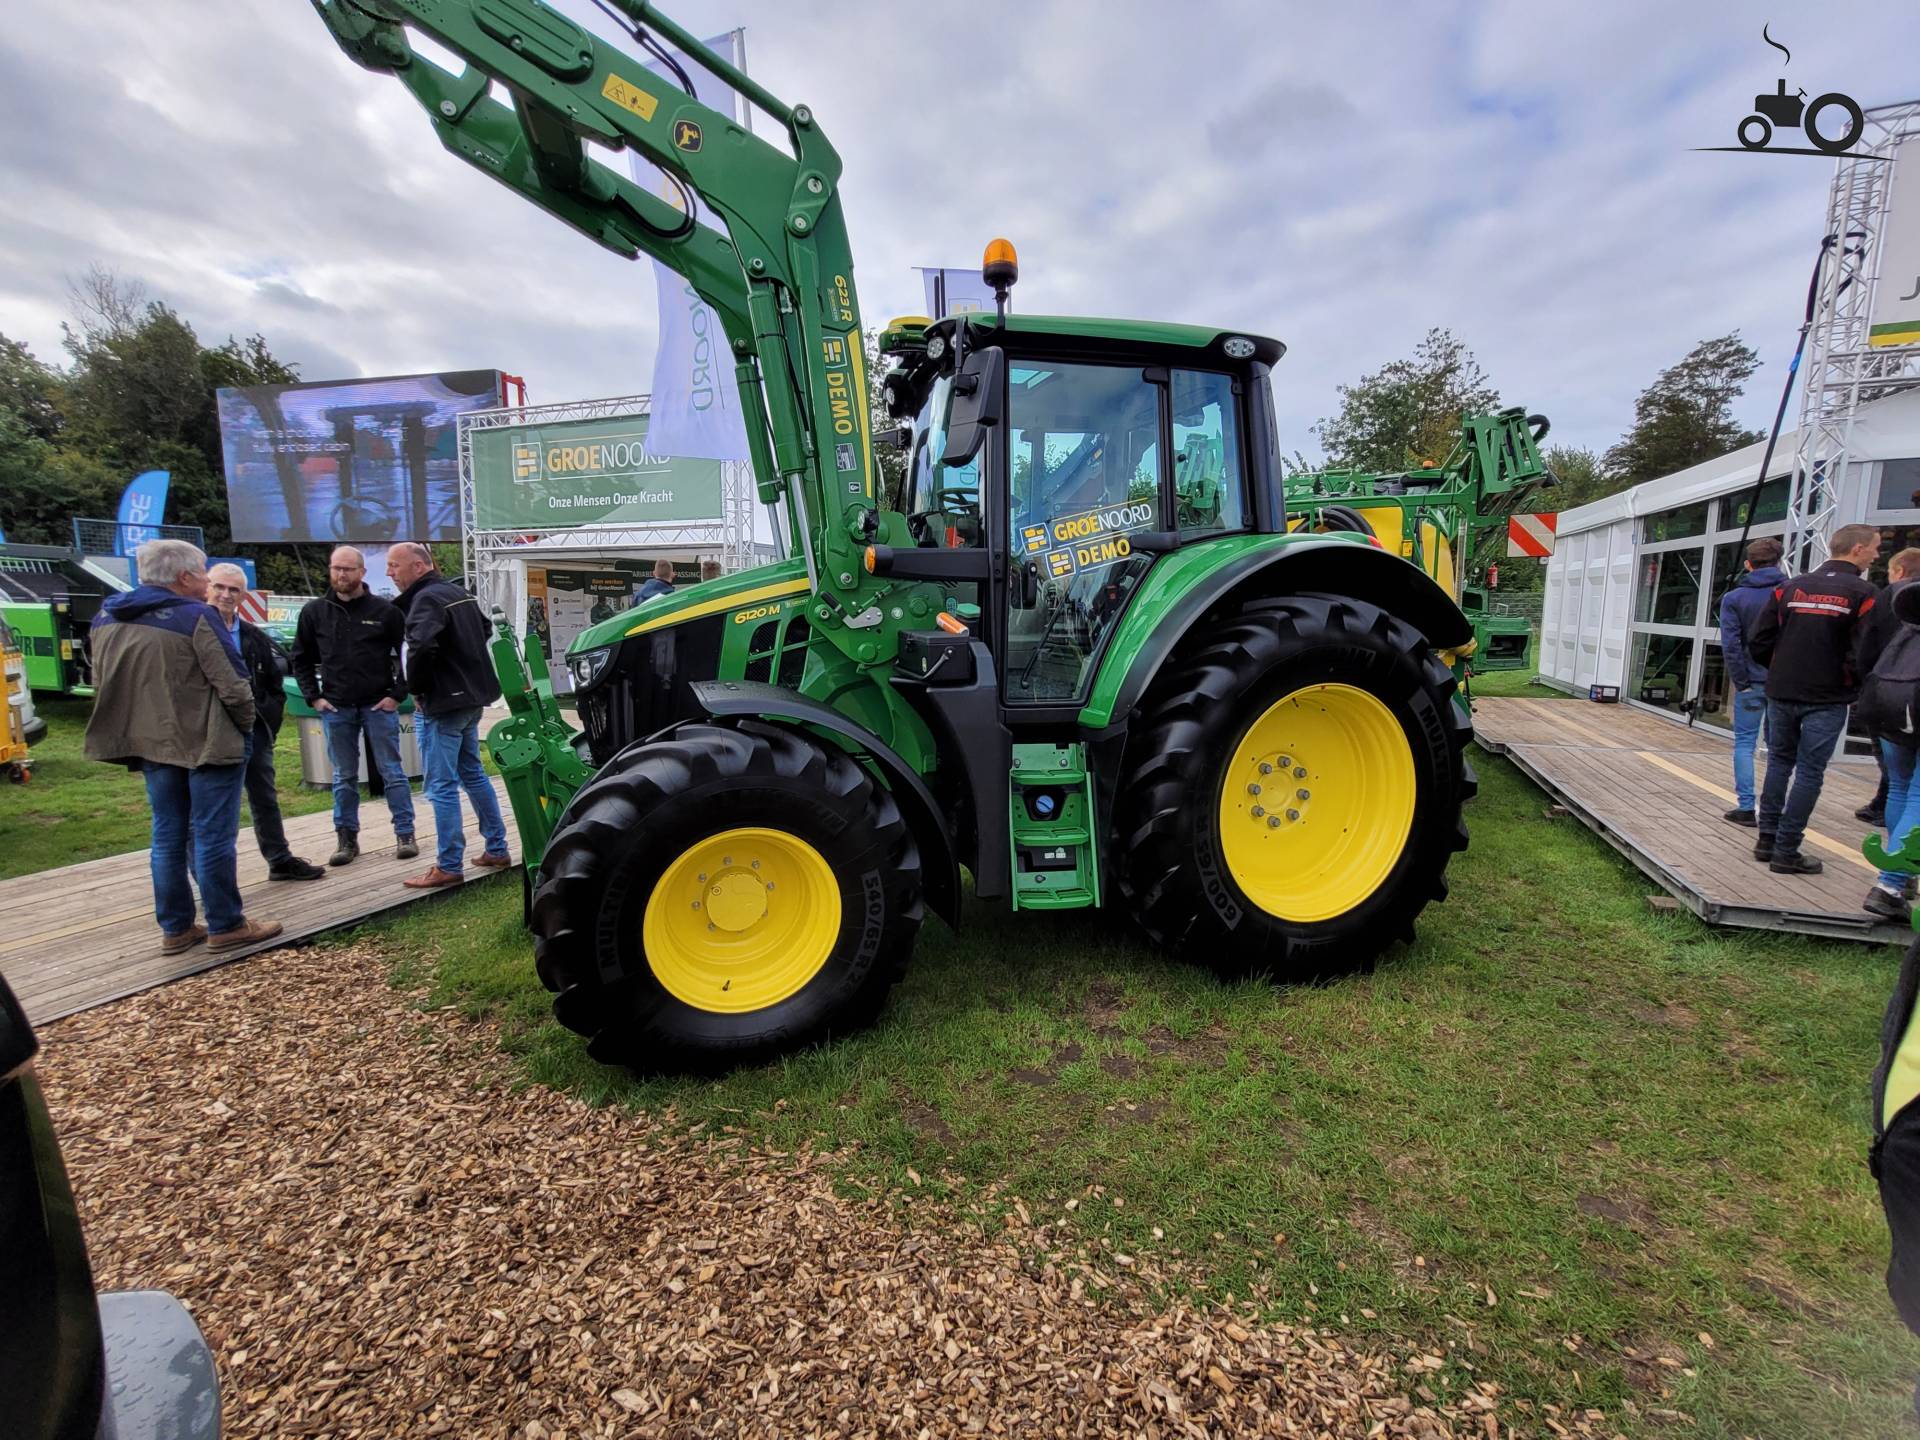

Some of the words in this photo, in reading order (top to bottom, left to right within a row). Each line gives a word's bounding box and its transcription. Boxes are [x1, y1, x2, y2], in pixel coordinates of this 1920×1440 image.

[834, 275, 850, 306] 623
[840, 308, 853, 322] R
[826, 372, 853, 435] DEMO
[548, 497, 572, 509] Onze
[574, 494, 611, 507] Mensen
[613, 493, 638, 505] Onze
[640, 490, 674, 503] Kracht
[1054, 504, 1152, 541] GROENOORD
[1077, 538, 1131, 567] DEMO
[735, 607, 767, 624] 6120
[768, 604, 781, 615] M
